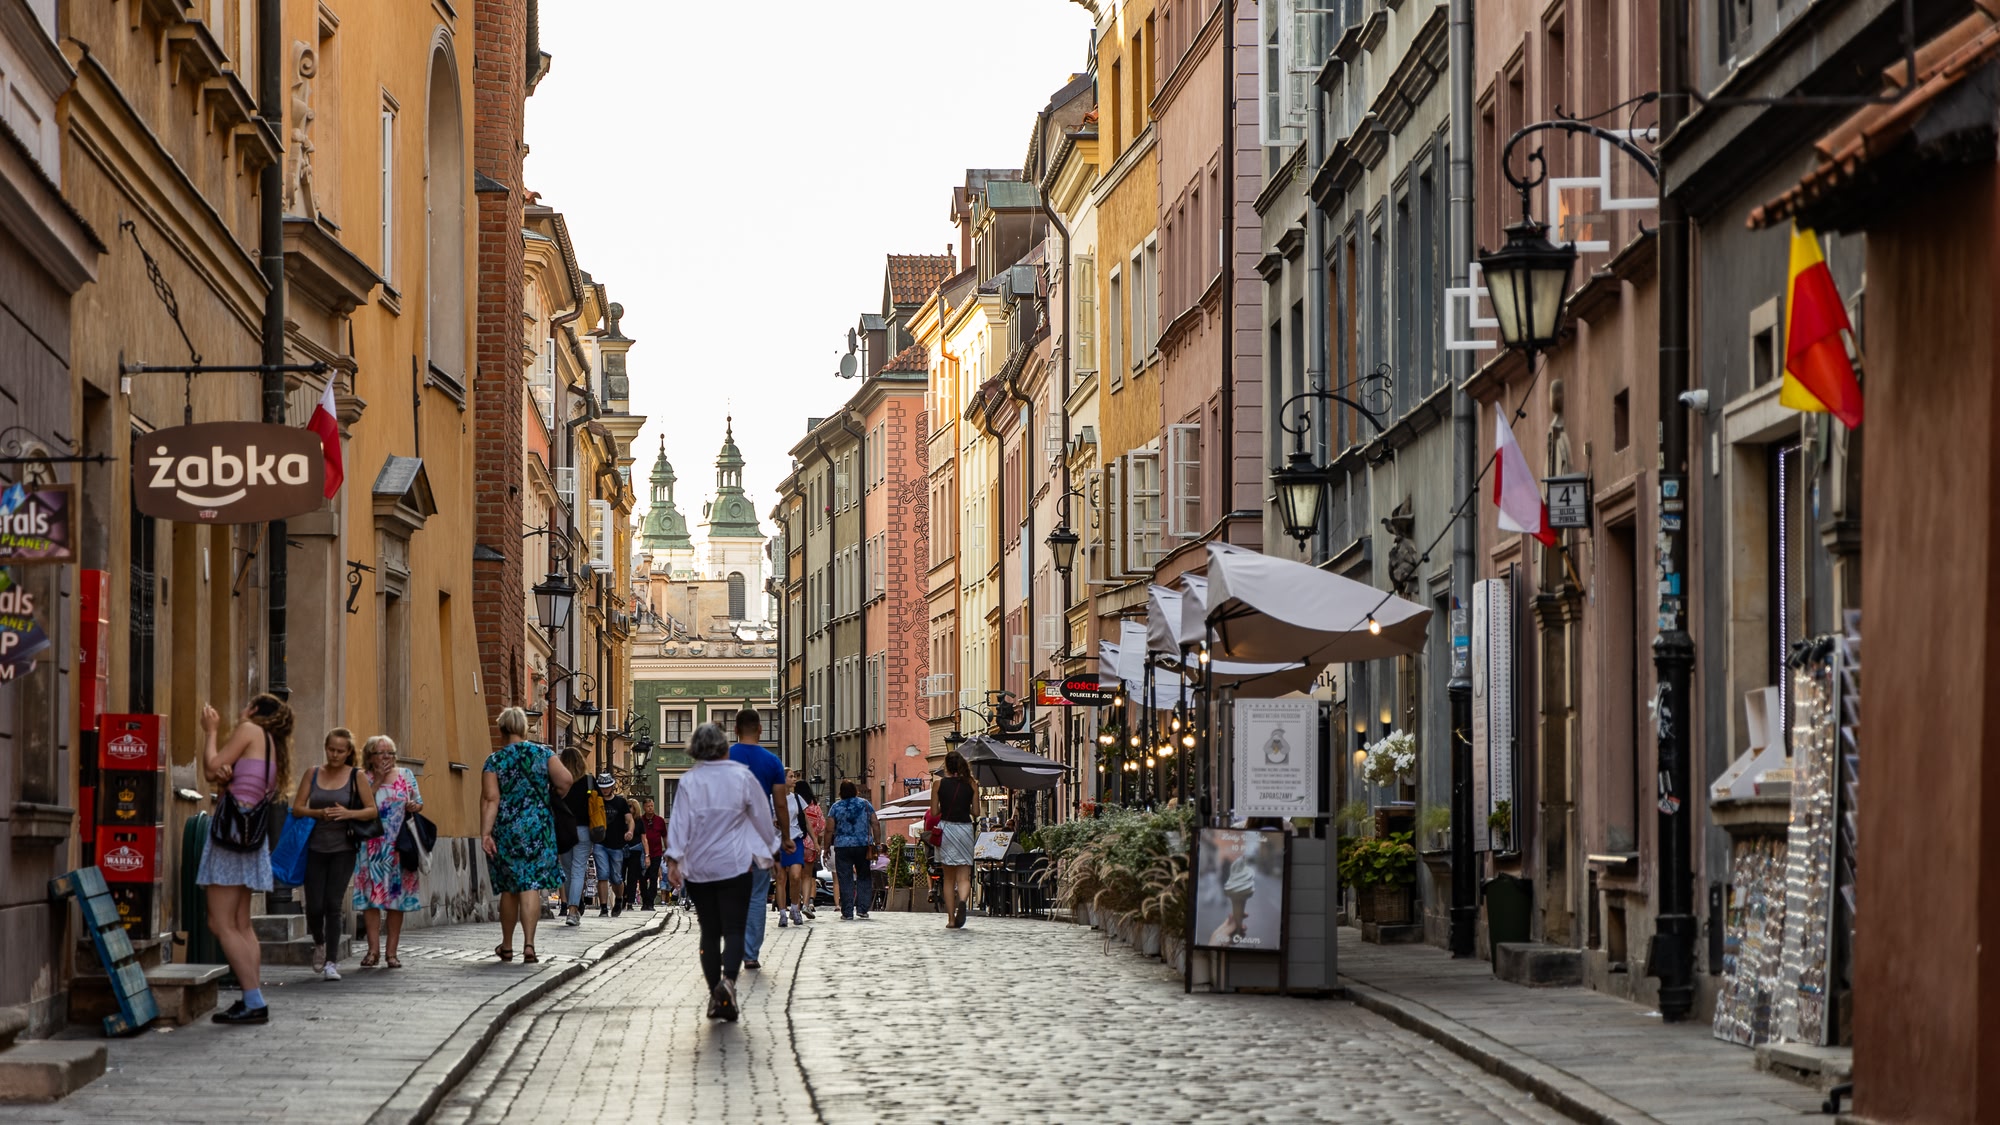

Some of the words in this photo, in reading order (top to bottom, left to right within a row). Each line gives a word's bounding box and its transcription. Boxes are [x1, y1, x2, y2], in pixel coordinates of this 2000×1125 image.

[149, 445, 309, 488] żabka
[1559, 507, 1576, 515] ULICA
[1, 533, 51, 552] PLANET
[110, 745, 144, 753] WARKA
[1259, 792, 1293, 800] ZAPRASZAMY
[106, 857, 140, 865] WARKA
